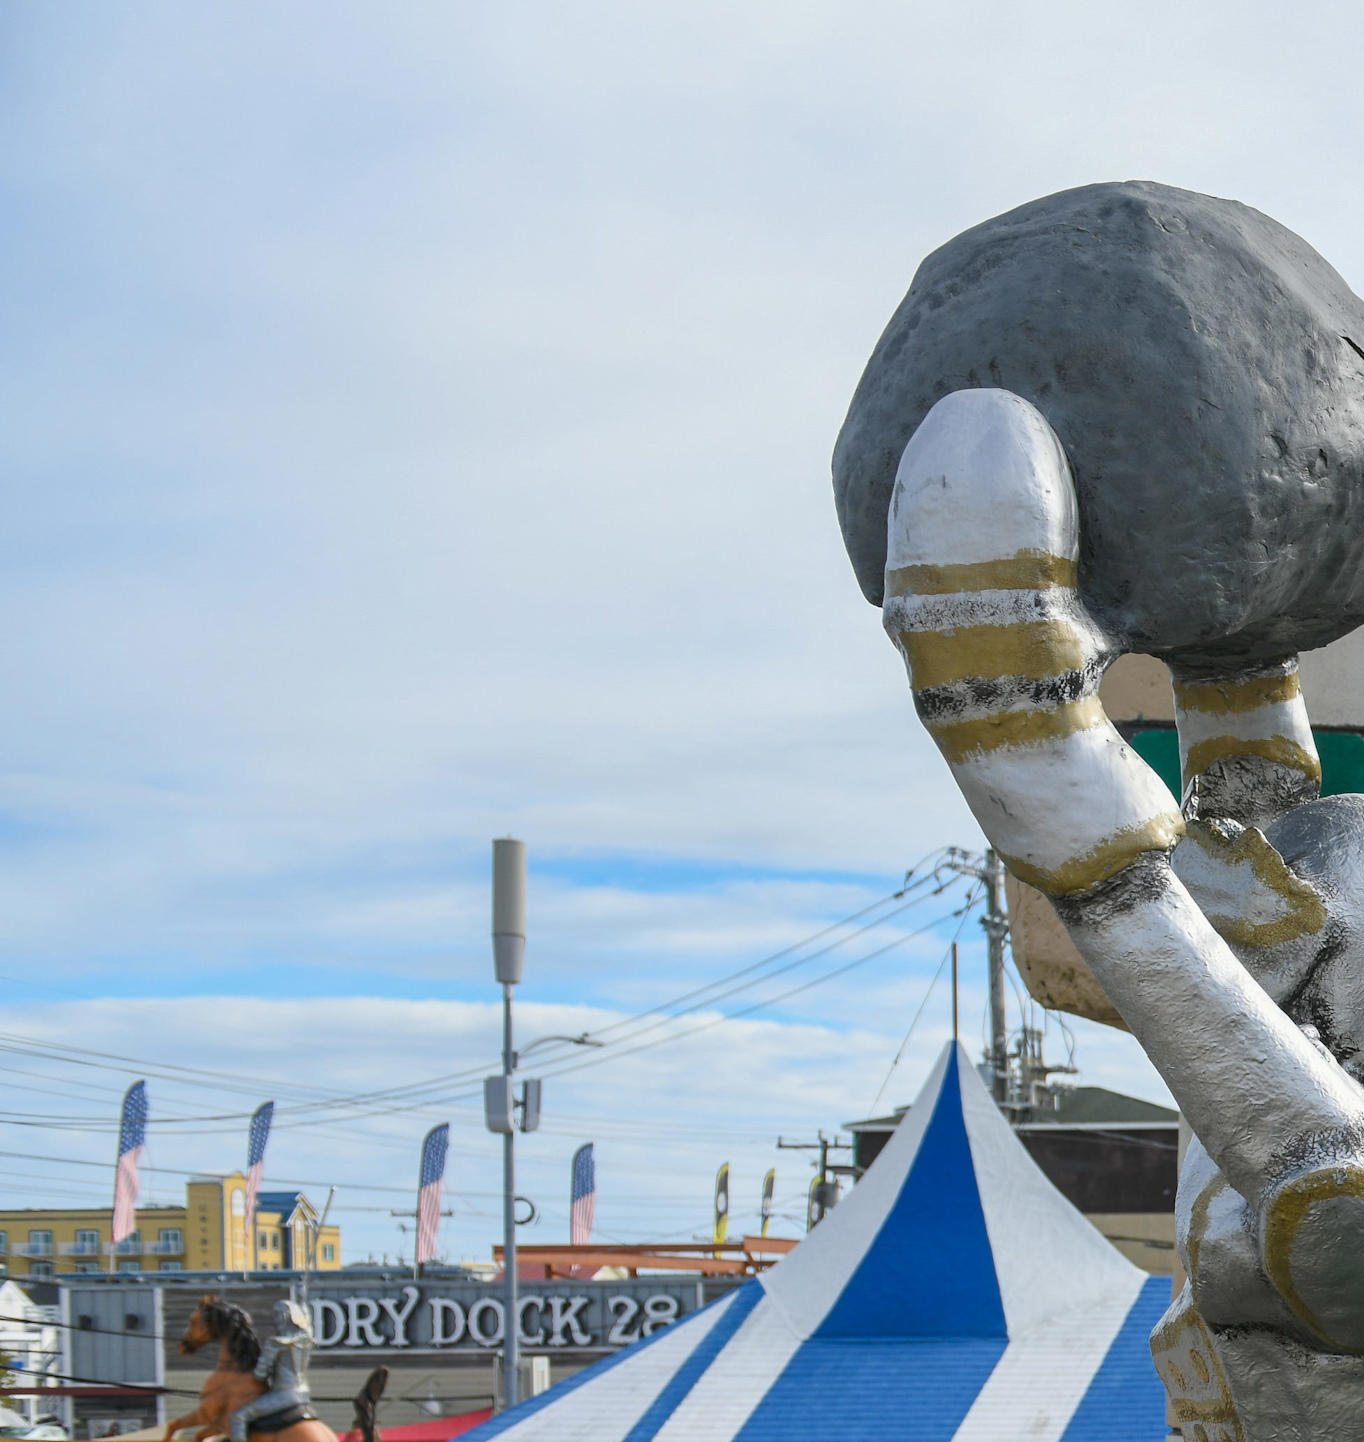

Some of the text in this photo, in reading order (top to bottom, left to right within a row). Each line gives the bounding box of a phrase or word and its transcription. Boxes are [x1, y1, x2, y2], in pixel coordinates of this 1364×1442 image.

[310, 1286, 679, 1347] DRY DOCK 28
